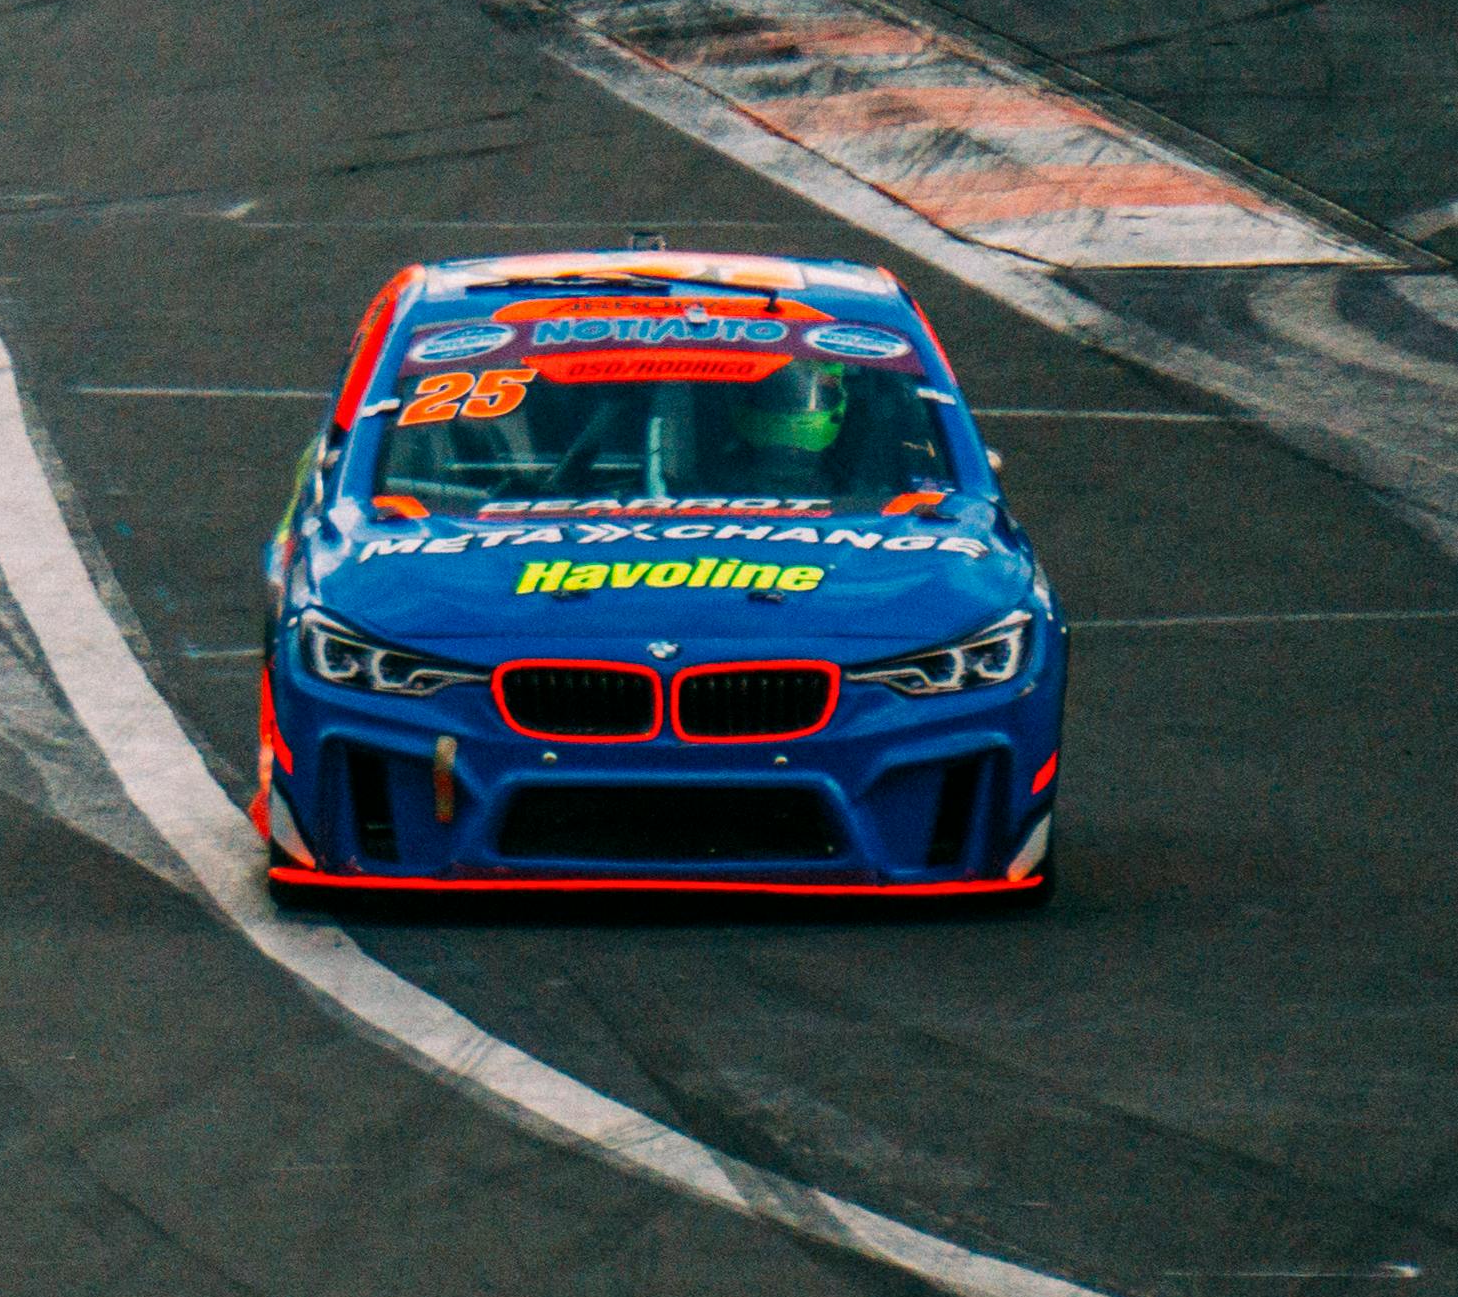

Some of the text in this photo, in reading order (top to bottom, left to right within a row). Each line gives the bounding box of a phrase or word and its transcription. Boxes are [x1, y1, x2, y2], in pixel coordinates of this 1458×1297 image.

[532, 318, 789, 345] NOTIAUTO
[395, 368, 541, 427] 25
[514, 557, 826, 595] Havoline
